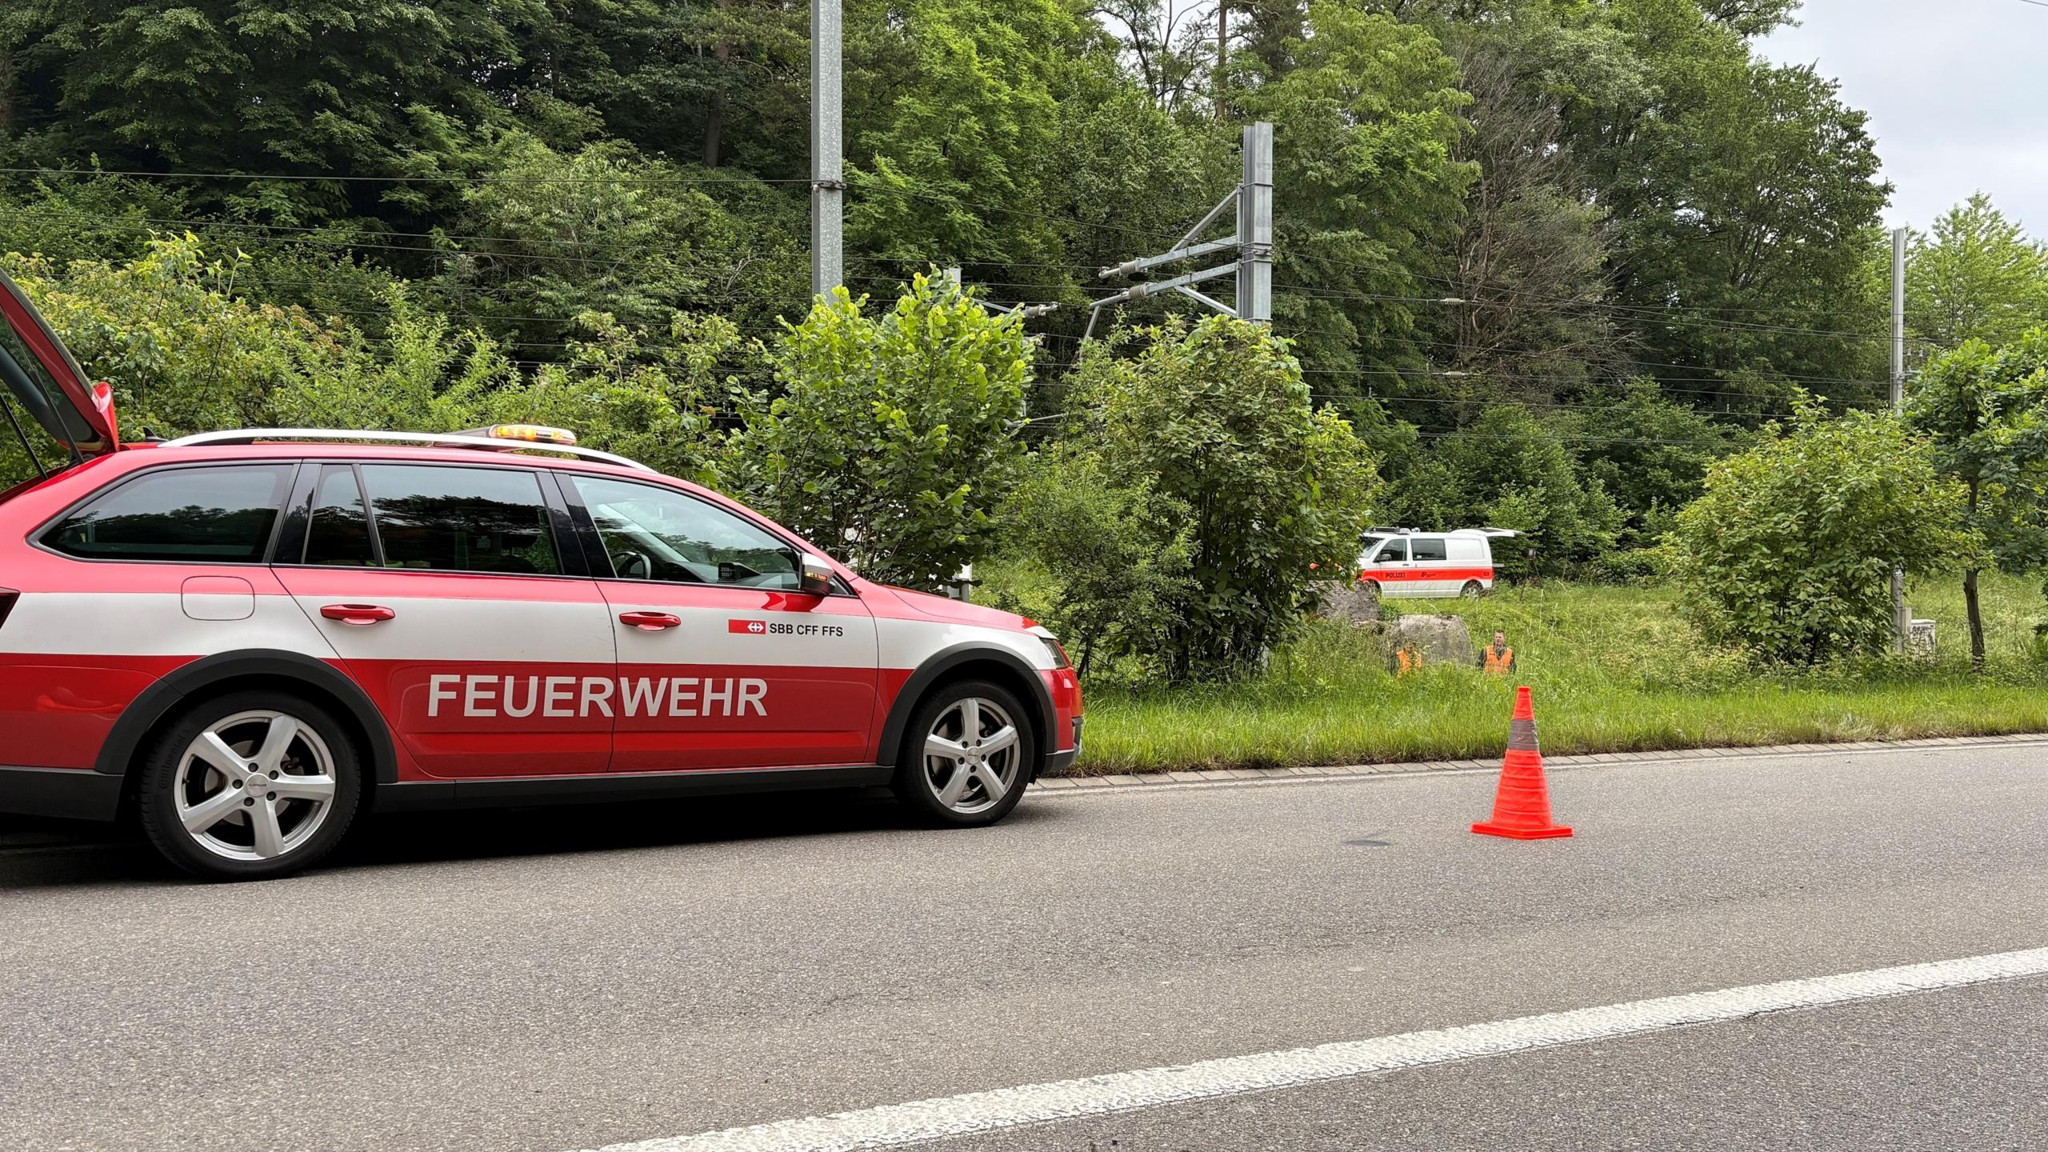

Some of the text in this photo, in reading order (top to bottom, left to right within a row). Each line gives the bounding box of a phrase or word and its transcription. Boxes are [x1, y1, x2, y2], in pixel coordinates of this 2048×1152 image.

[769, 623, 843, 637] SBB CFF FFS
[427, 674, 768, 717] FEUERWEHR
